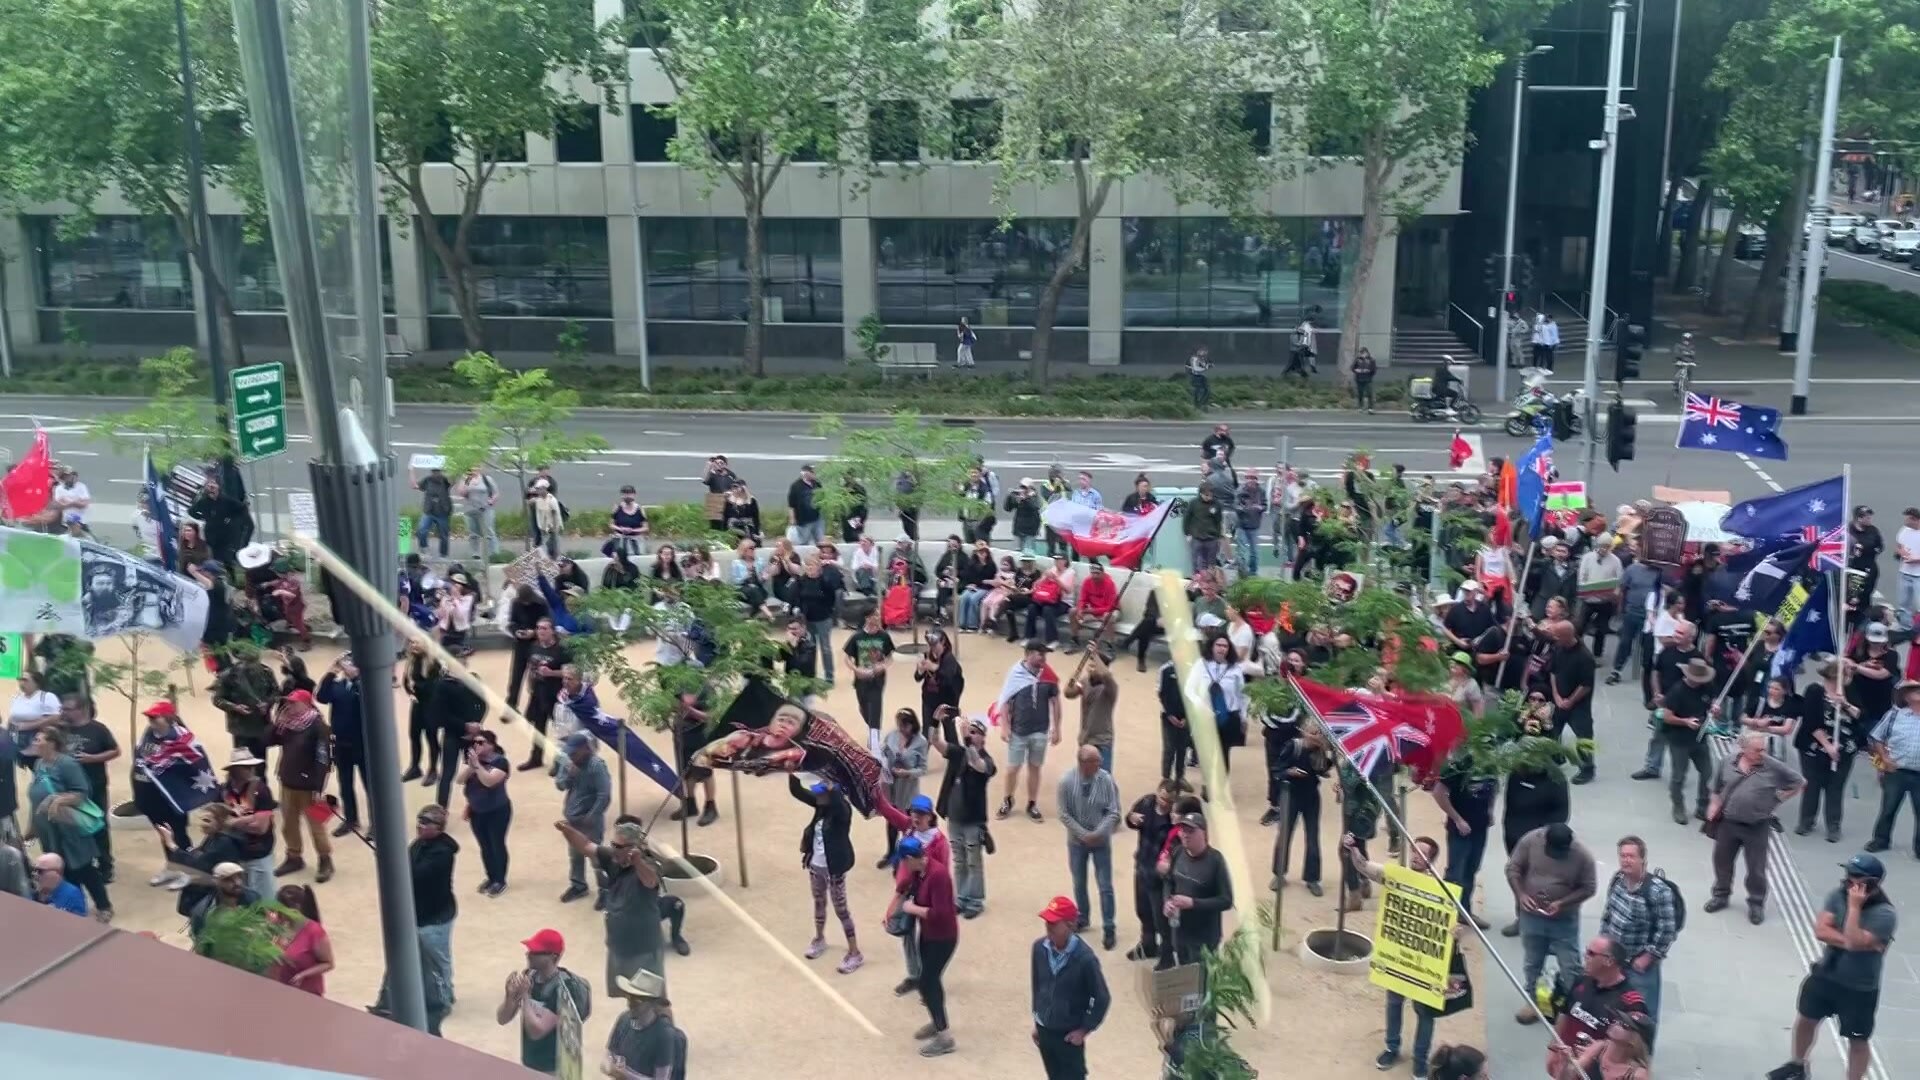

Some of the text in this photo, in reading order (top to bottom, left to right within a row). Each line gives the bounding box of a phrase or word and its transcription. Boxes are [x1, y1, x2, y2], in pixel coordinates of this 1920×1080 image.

[1383, 908, 1447, 943] FREEDOM
[1386, 893, 1449, 926] FREEDOM
[1381, 924, 1445, 960] FREEDOM
